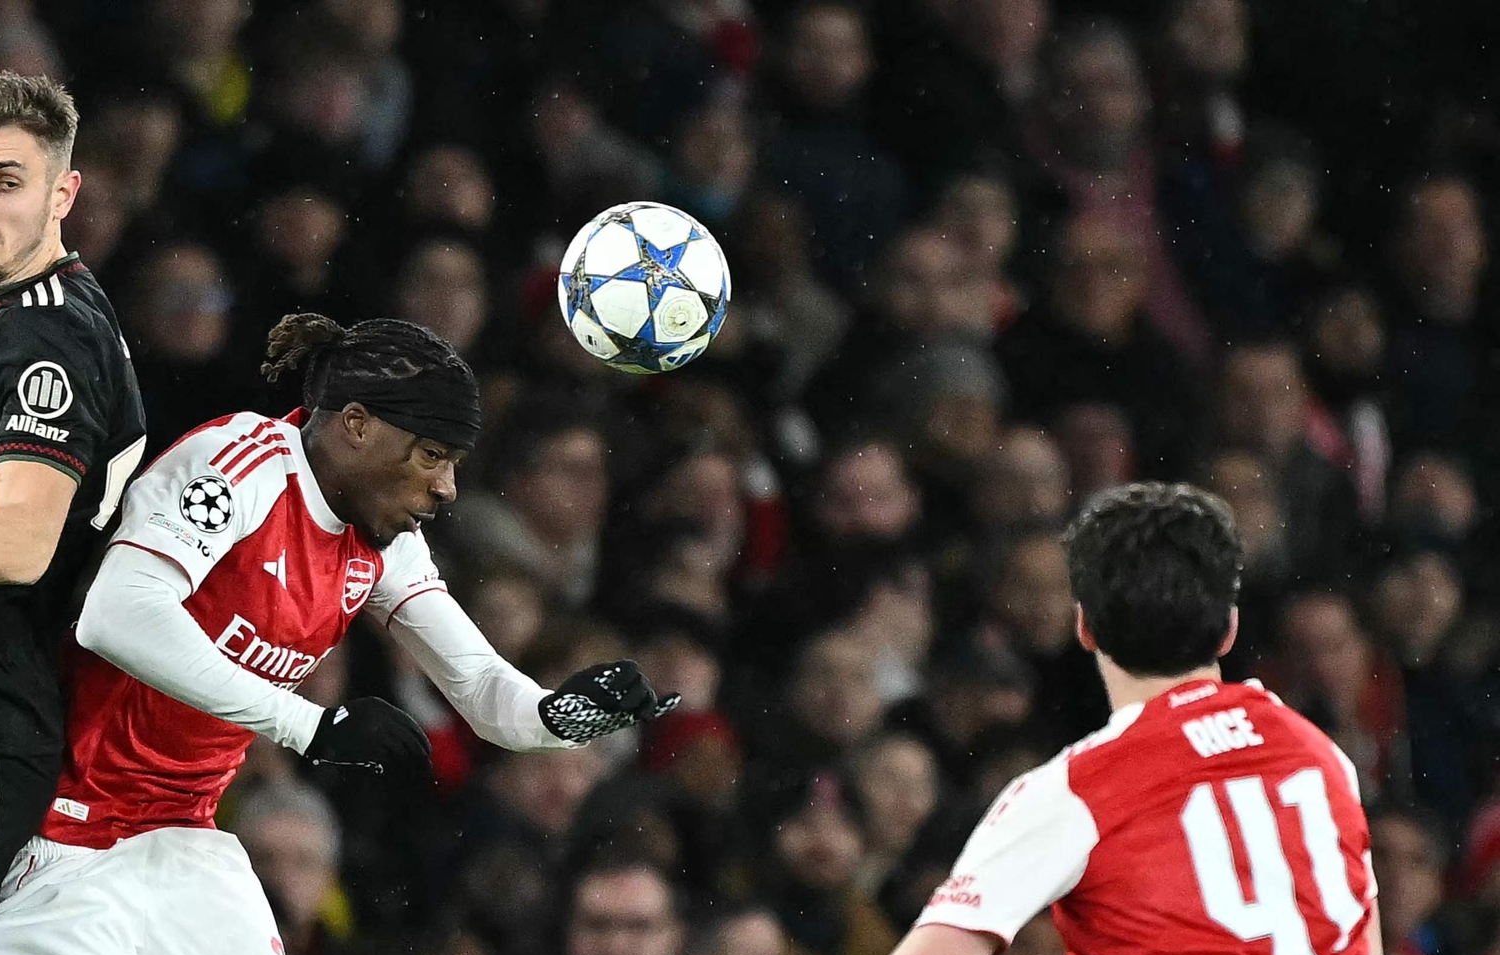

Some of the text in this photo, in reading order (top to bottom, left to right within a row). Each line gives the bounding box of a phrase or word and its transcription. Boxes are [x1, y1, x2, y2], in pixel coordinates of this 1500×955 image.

[5, 413, 70, 443] Allianz
[215, 613, 332, 680] Emira
[1181, 706, 1265, 758] RICE
